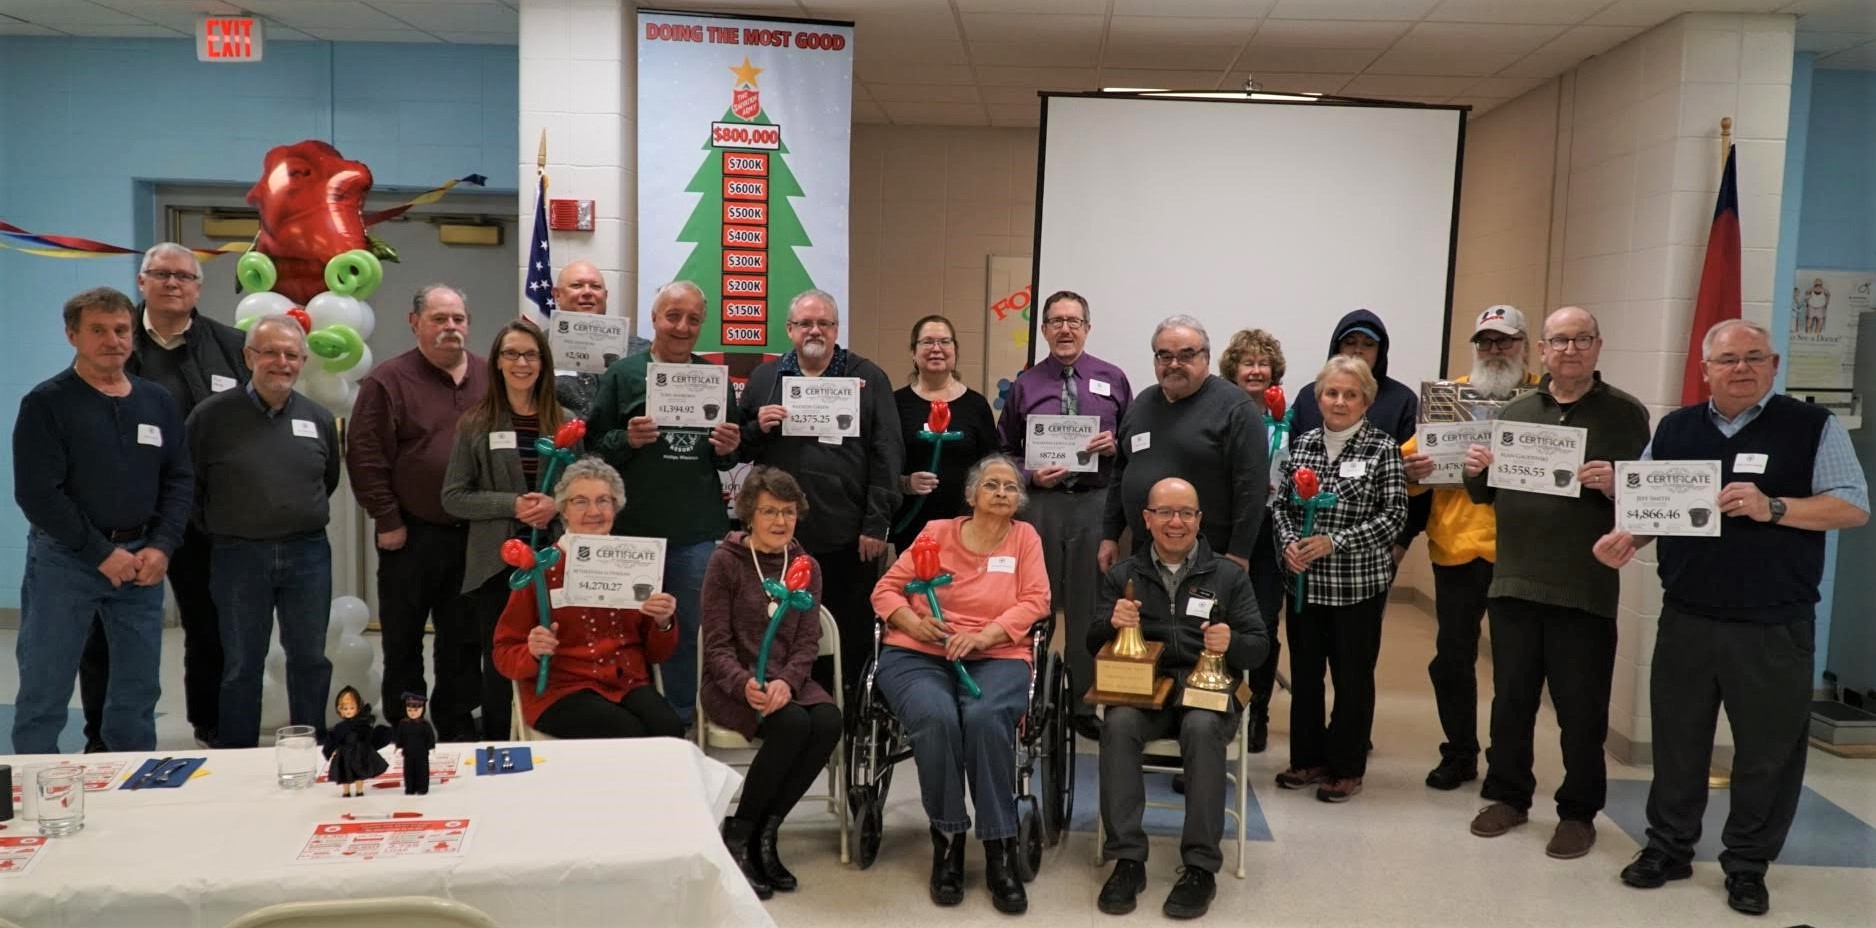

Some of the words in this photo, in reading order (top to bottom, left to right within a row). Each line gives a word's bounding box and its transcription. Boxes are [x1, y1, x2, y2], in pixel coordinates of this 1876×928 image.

[206, 18, 254, 58] EXIT
[645, 22, 704, 43] DOING
[706, 26, 740, 45] THE
[742, 28, 793, 48] MOST
[794, 32, 846, 51] GOOD
[712, 126, 778, 146] $800,000
[729, 157, 762, 170] $700K
[729, 182, 762, 195] $600K
[728, 206, 761, 219] $500K
[728, 230, 761, 243] $400K
[728, 255, 761, 268] $300K
[728, 279, 761, 292] $200K
[991, 283, 1032, 321] FO
[727, 304, 761, 317] $150K
[573, 323, 622, 335] CERTIFICATE
[727, 328, 761, 341] $100K
[671, 375, 721, 385] CERTIFICATE
[805, 388, 852, 396] CERTIFICATE
[791, 414, 831, 424] $2,375.25
[1048, 425, 1092, 433] CERTIFICATE
[1519, 434, 1577, 449] CERTIFICATE
[1497, 463, 1546, 478] $3,558.55
[1646, 474, 1712, 484] CERTIFICATE
[1626, 508, 1681, 520] $4,866.46
[596, 549, 656, 561] CERTIFICATE
[578, 581, 623, 592] $4,270.27
